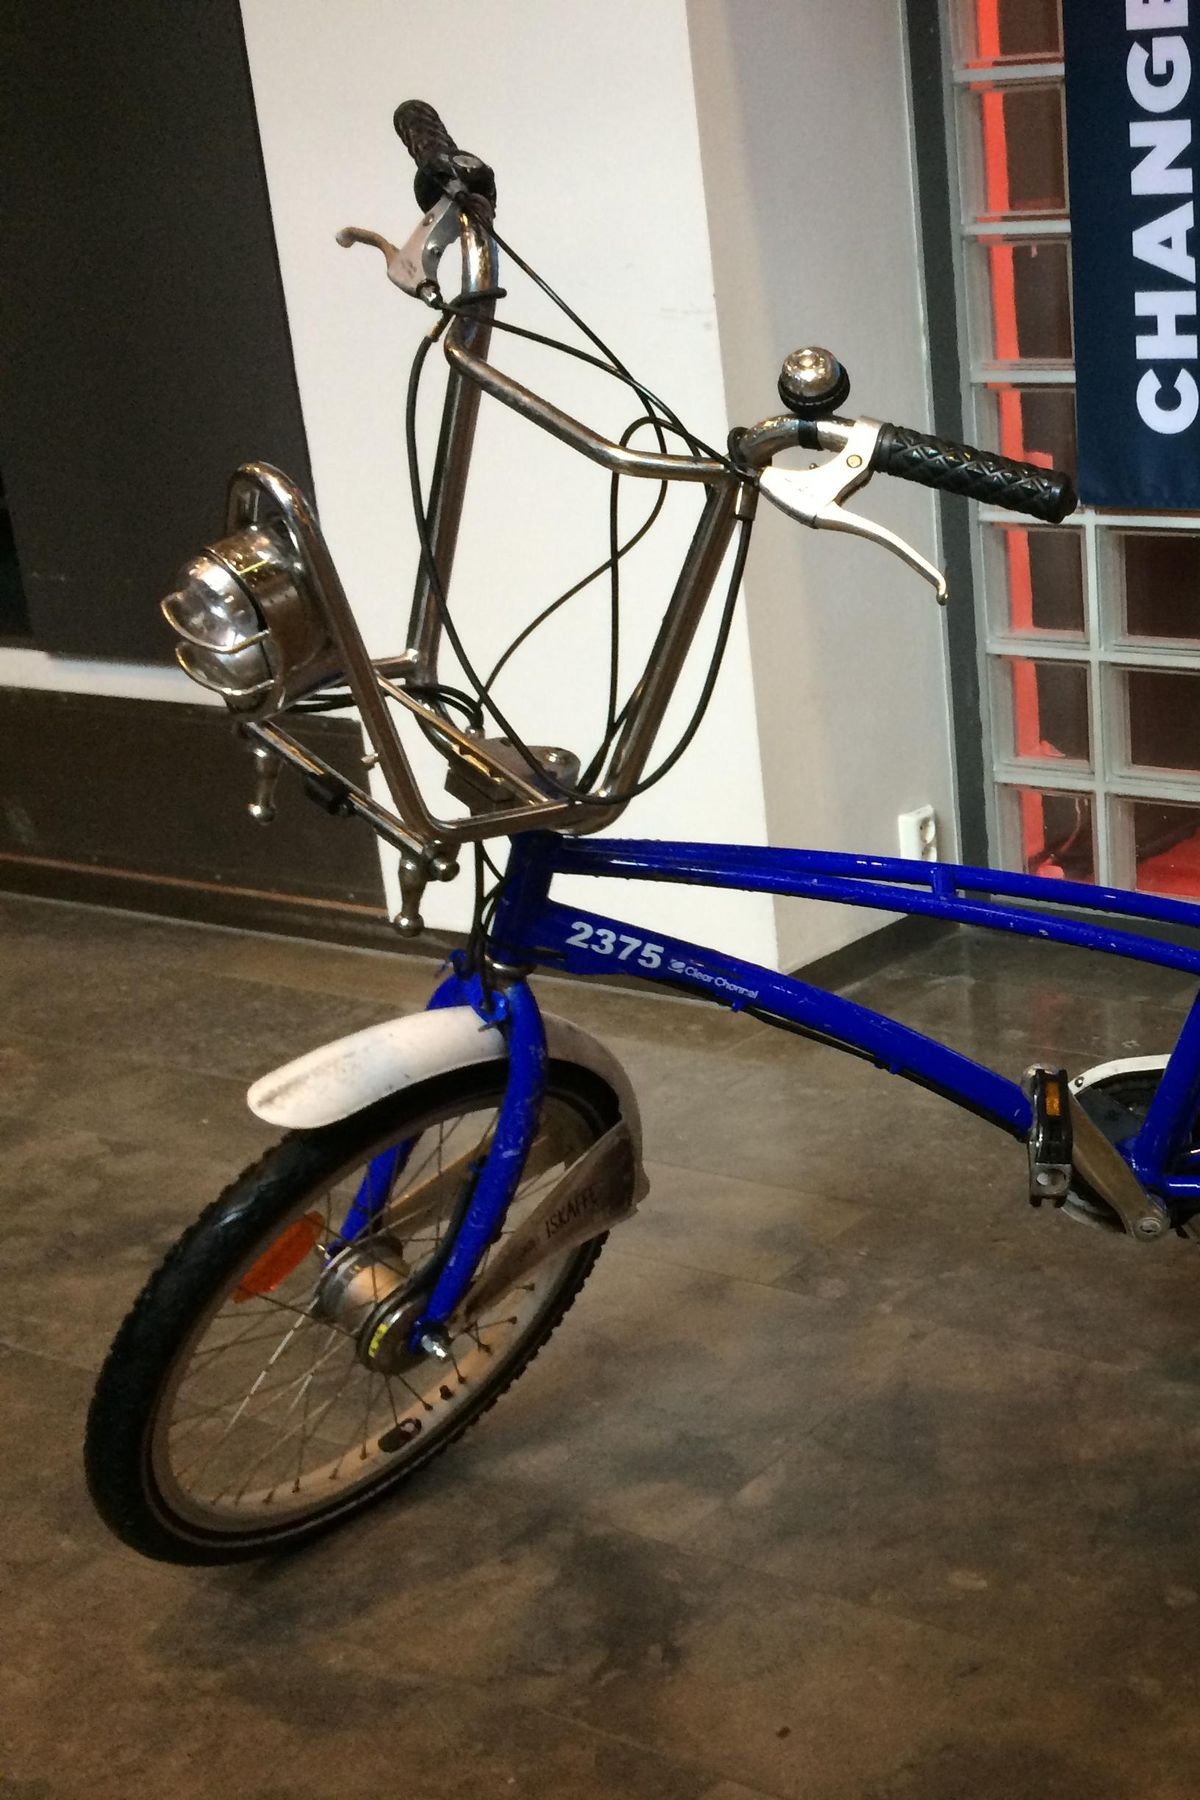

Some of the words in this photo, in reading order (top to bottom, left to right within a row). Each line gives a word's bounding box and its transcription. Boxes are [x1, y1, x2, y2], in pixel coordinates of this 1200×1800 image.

[1126, 0, 1200, 435] CHANGE
[566, 921, 664, 969] 2375
[684, 966, 714, 983] Clear
[714, 977, 759, 999] Channel
